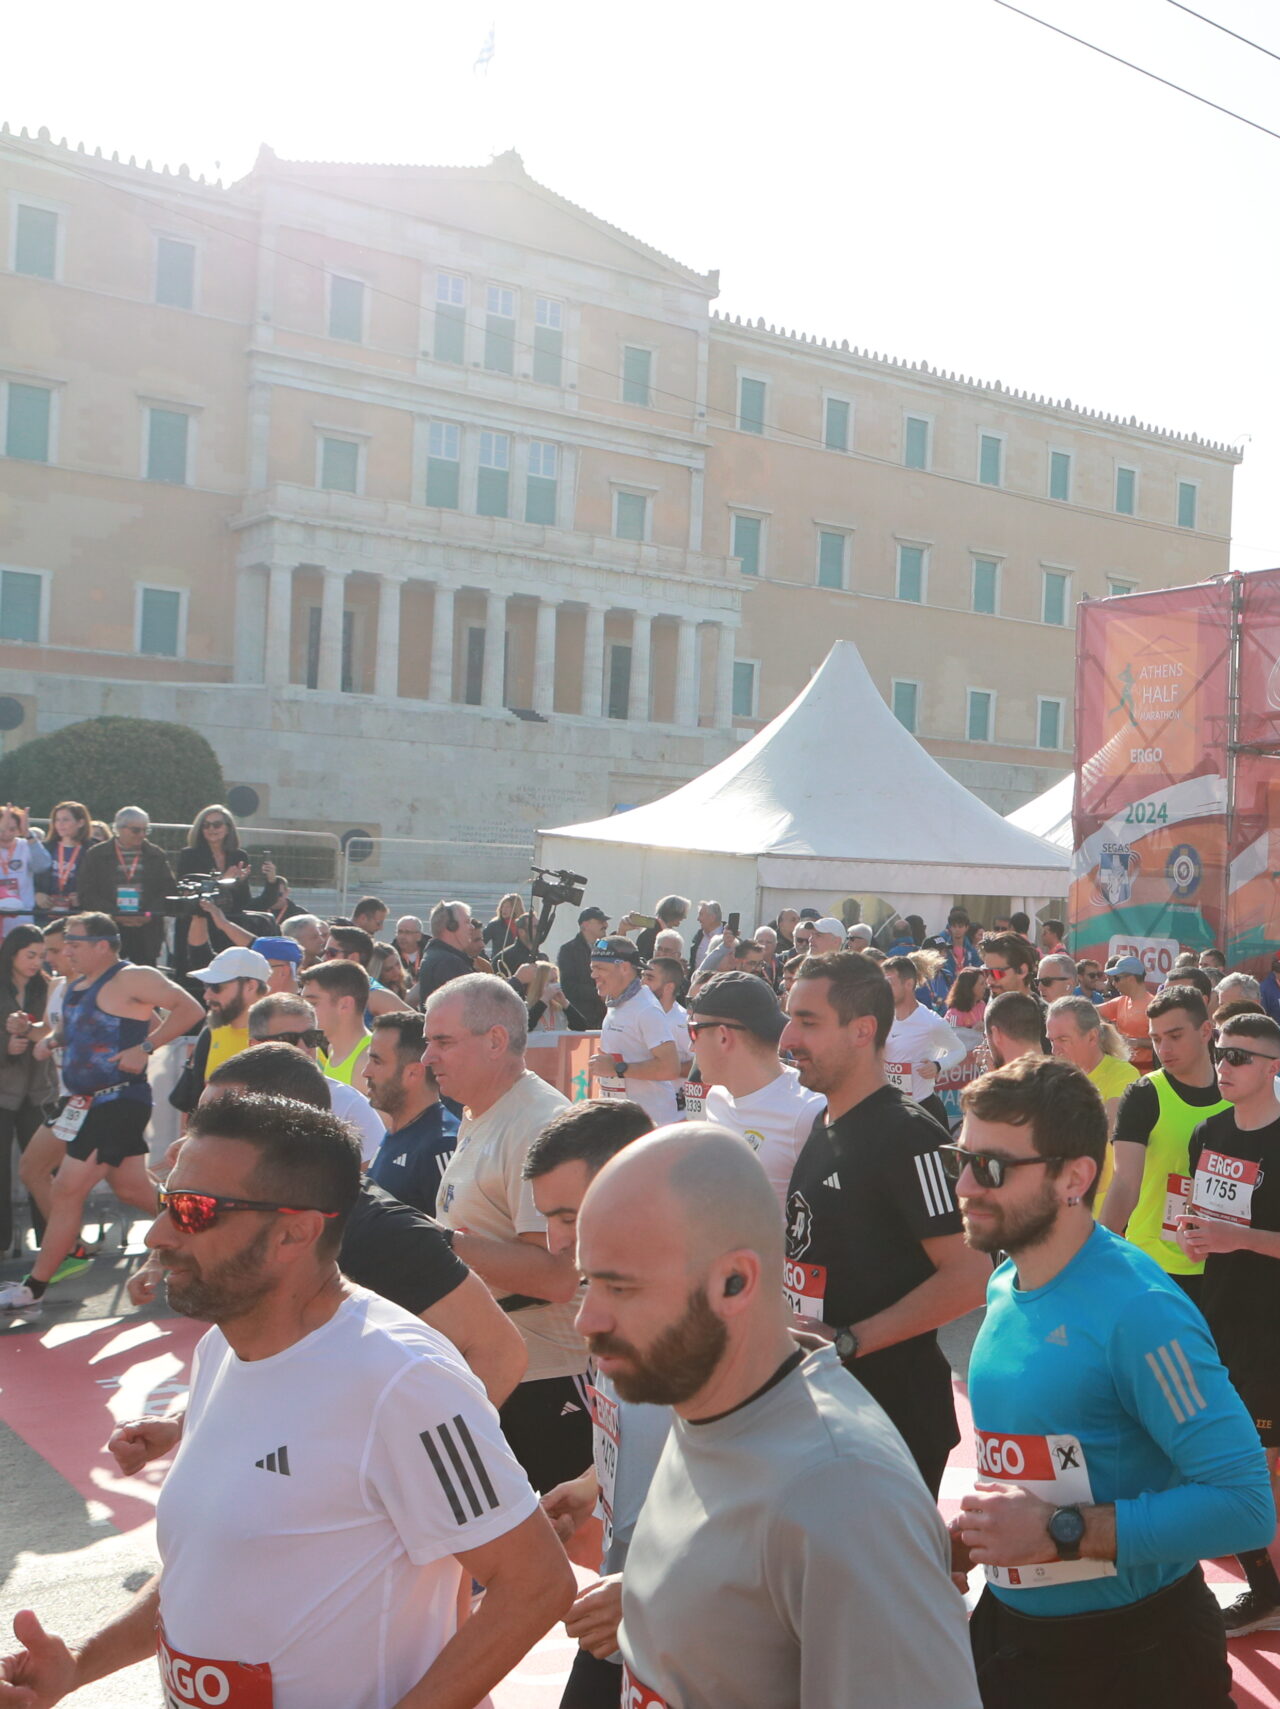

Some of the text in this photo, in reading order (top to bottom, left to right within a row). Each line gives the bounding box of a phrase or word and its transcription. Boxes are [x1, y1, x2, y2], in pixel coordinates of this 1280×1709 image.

[1139, 663, 1184, 680] ATHENS
[1142, 683, 1180, 704] HALF
[1139, 709, 1181, 722] MARATHON
[1130, 747, 1163, 763] ERGO
[1124, 801, 1169, 825] 2024
[1102, 843, 1130, 853] SEGAS
[1207, 1153, 1244, 1179] ERGO
[1205, 1176, 1238, 1201] 1755
[975, 1436, 1025, 1476] RGO
[160, 1640, 231, 1707] RGO
